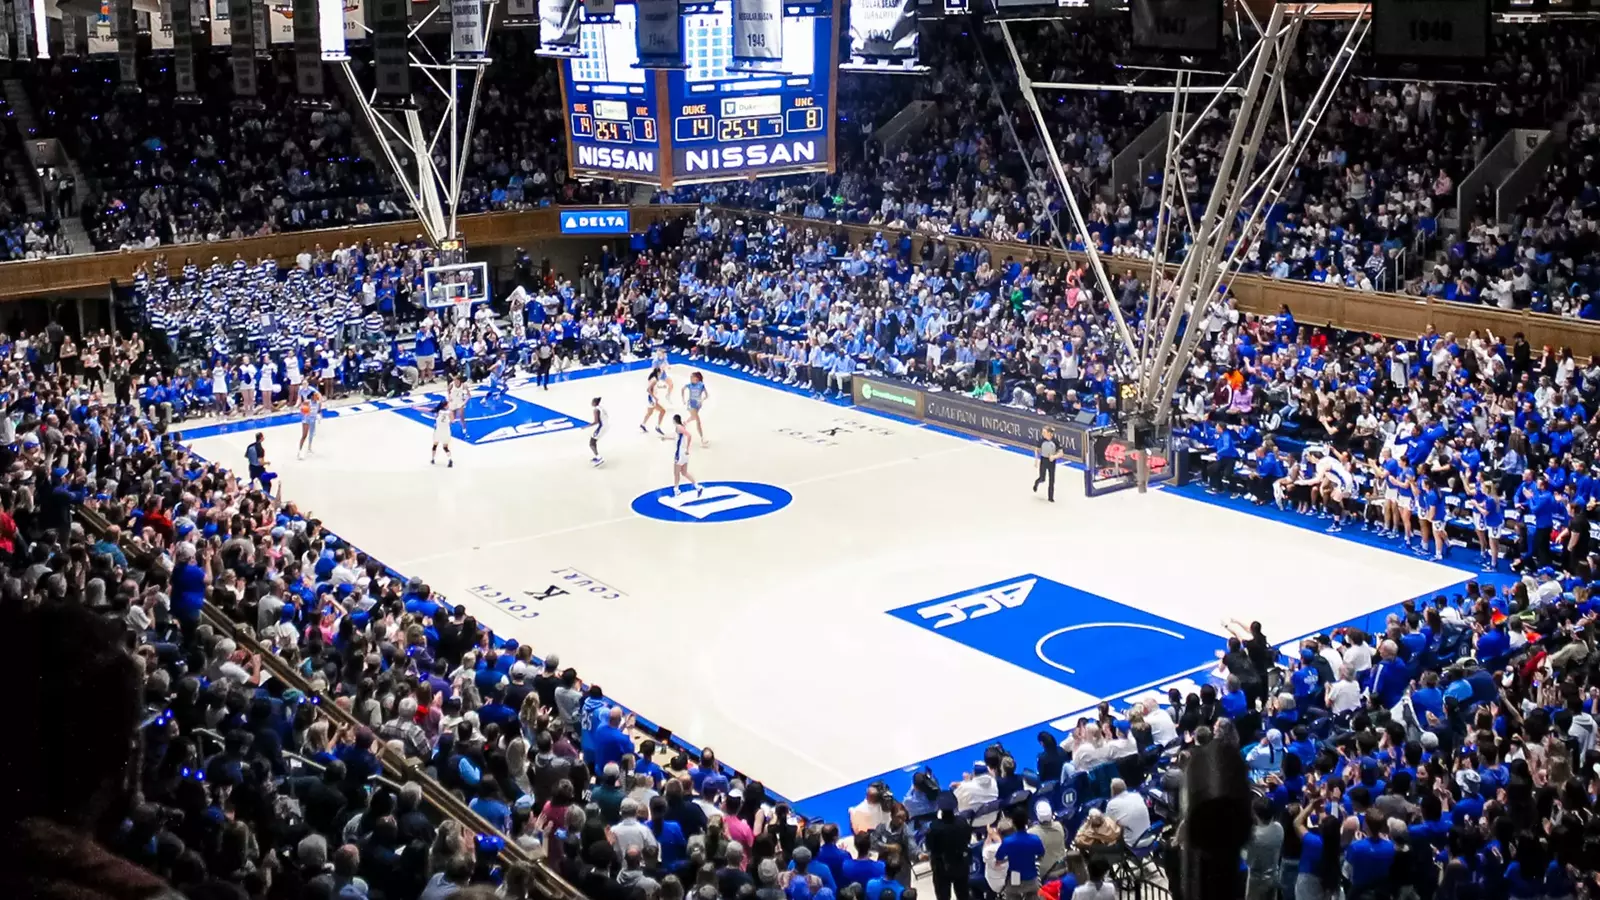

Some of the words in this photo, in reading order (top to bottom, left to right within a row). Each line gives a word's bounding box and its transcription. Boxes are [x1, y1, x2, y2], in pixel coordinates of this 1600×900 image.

[747, 33, 765, 47] 1943
[682, 104, 707, 115] DUKE
[795, 97, 814, 107] UNC
[579, 117, 591, 133] 14
[692, 119, 709, 136] 14
[806, 109, 817, 128] 8
[596, 121, 619, 140] 25.4
[643, 120, 654, 139] 8
[722, 119, 759, 140] 25.4
[578, 145, 653, 172] NISSAN
[684, 141, 815, 172] NISSAN
[580, 217, 625, 228] DELTA
[475, 417, 574, 443] ACC
[928, 402, 977, 425] CAMERON
[981, 416, 1022, 437] INDOOR
[1028, 427, 1077, 450] STIUM
[523, 584, 571, 601] K
[550, 567, 621, 601] COURT
[471, 583, 540, 620] COACH
[916, 577, 1039, 629] ACC
